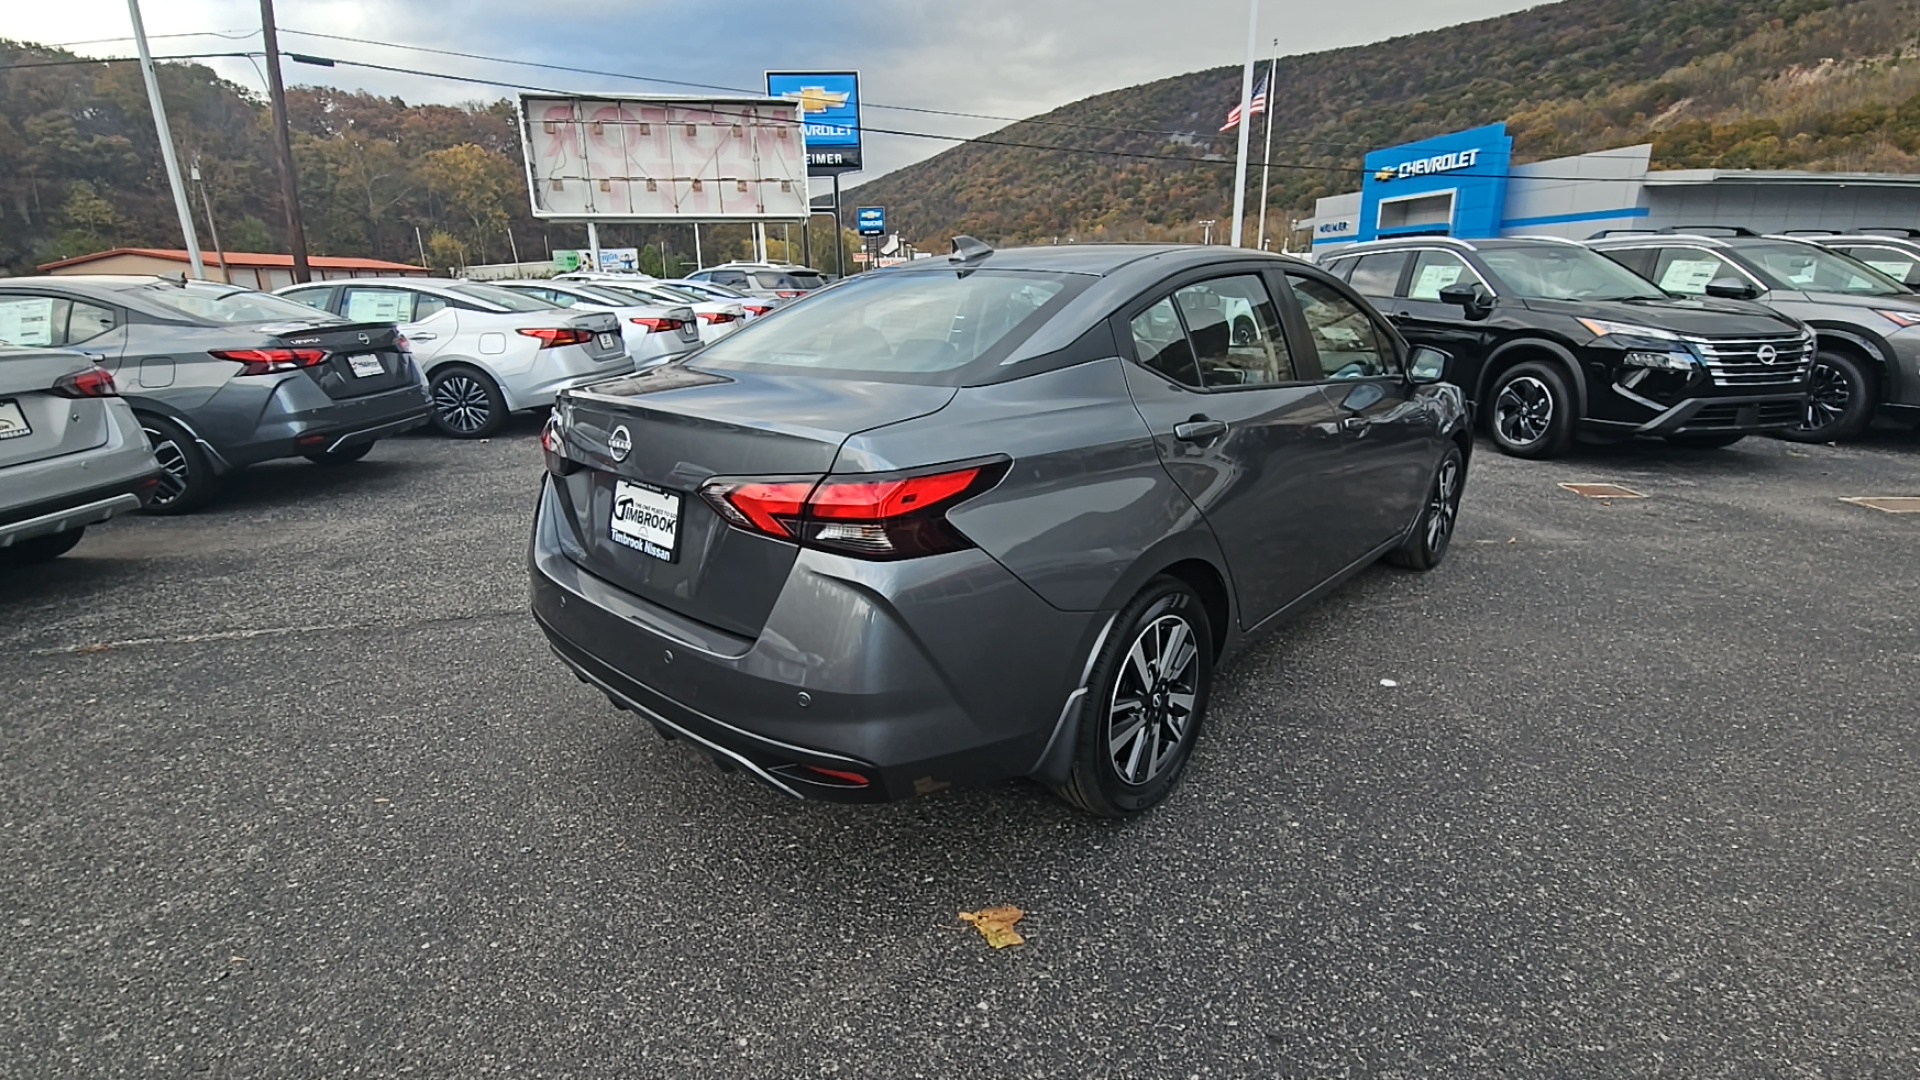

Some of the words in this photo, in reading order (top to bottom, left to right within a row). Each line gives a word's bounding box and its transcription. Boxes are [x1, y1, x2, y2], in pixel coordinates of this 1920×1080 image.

[1398, 148, 1481, 179] CHEVROLET
[614, 497, 676, 535] TIMBROOK
[611, 528, 643, 551] Timbrook
[644, 540, 670, 562] Nissan
